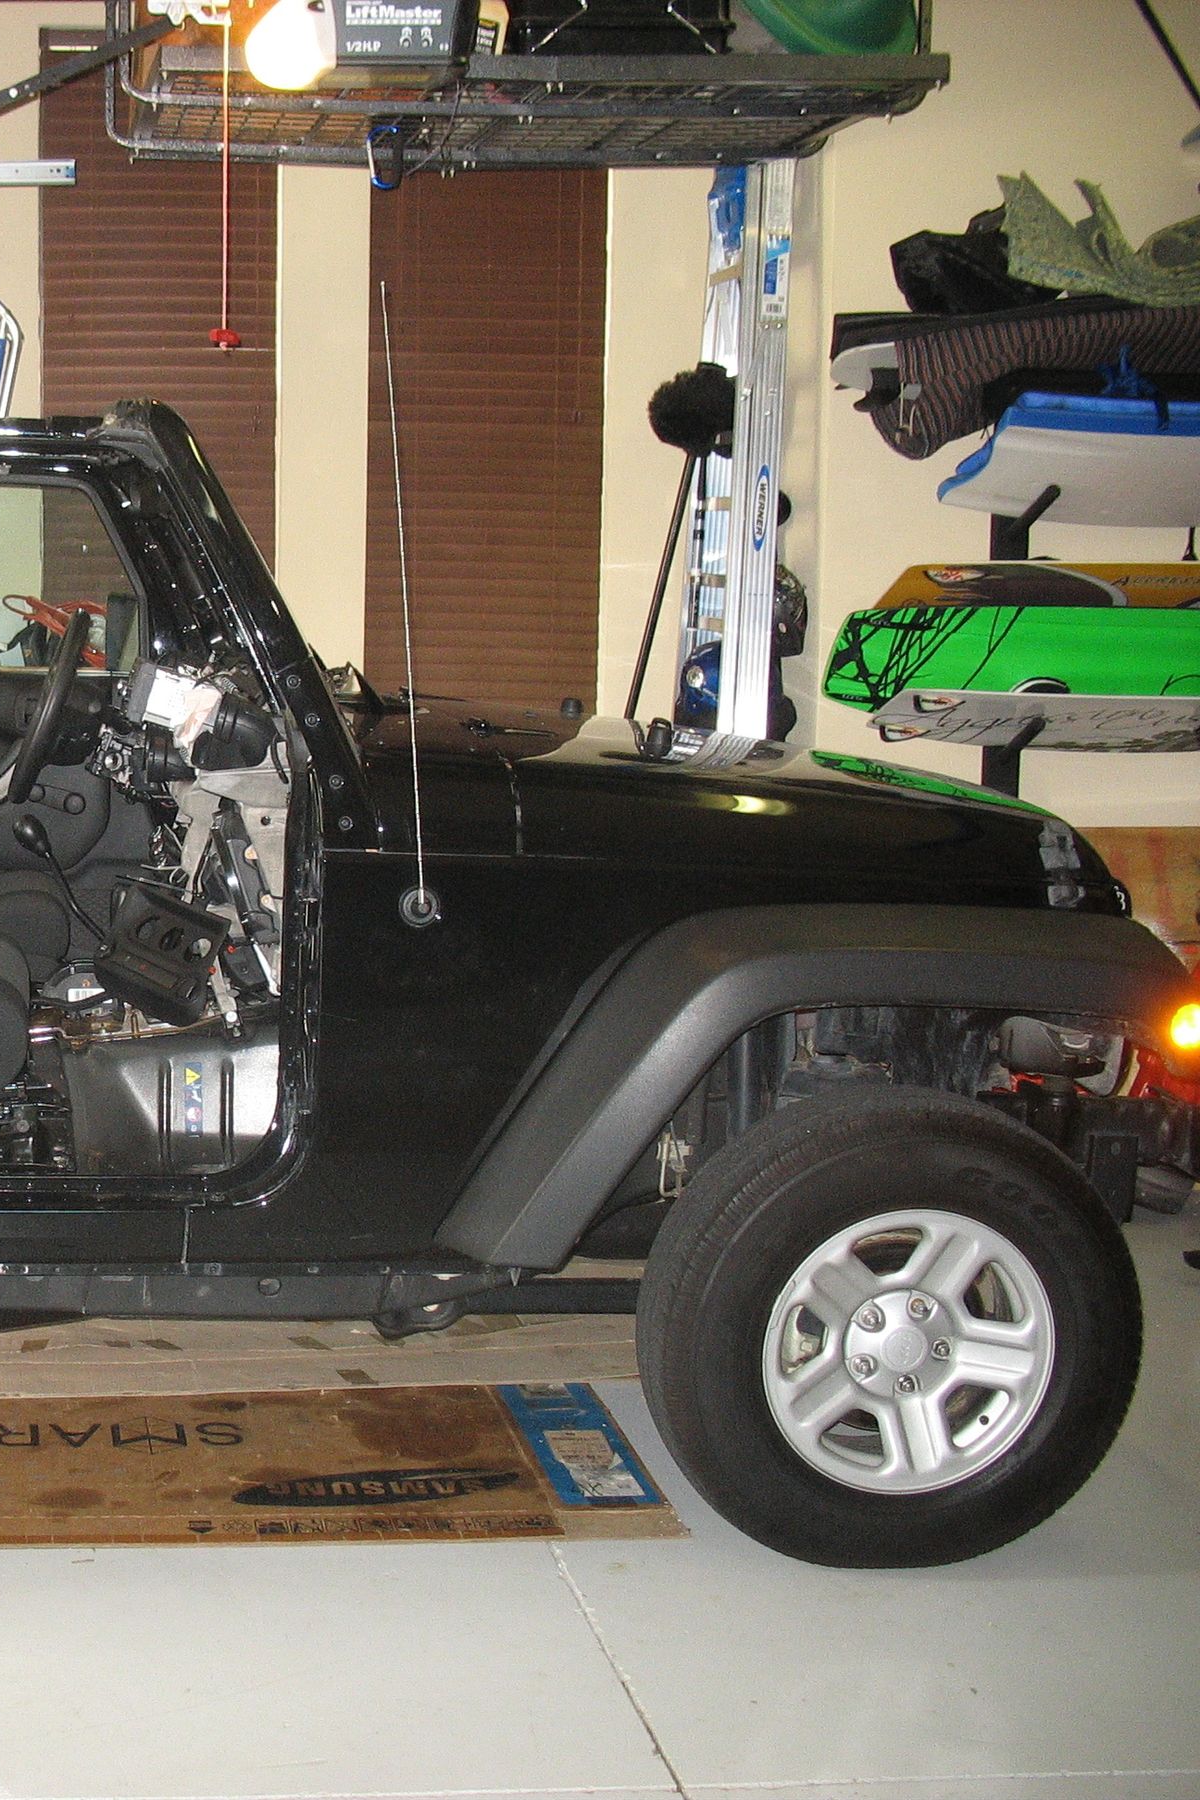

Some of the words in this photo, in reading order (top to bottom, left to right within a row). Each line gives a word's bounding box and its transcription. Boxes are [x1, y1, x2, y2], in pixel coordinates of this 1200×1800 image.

[346, 4, 441, 18] LiftMaster
[756, 482, 766, 536] WERNER
[263, 1477, 486, 1499] SAMSUNG
